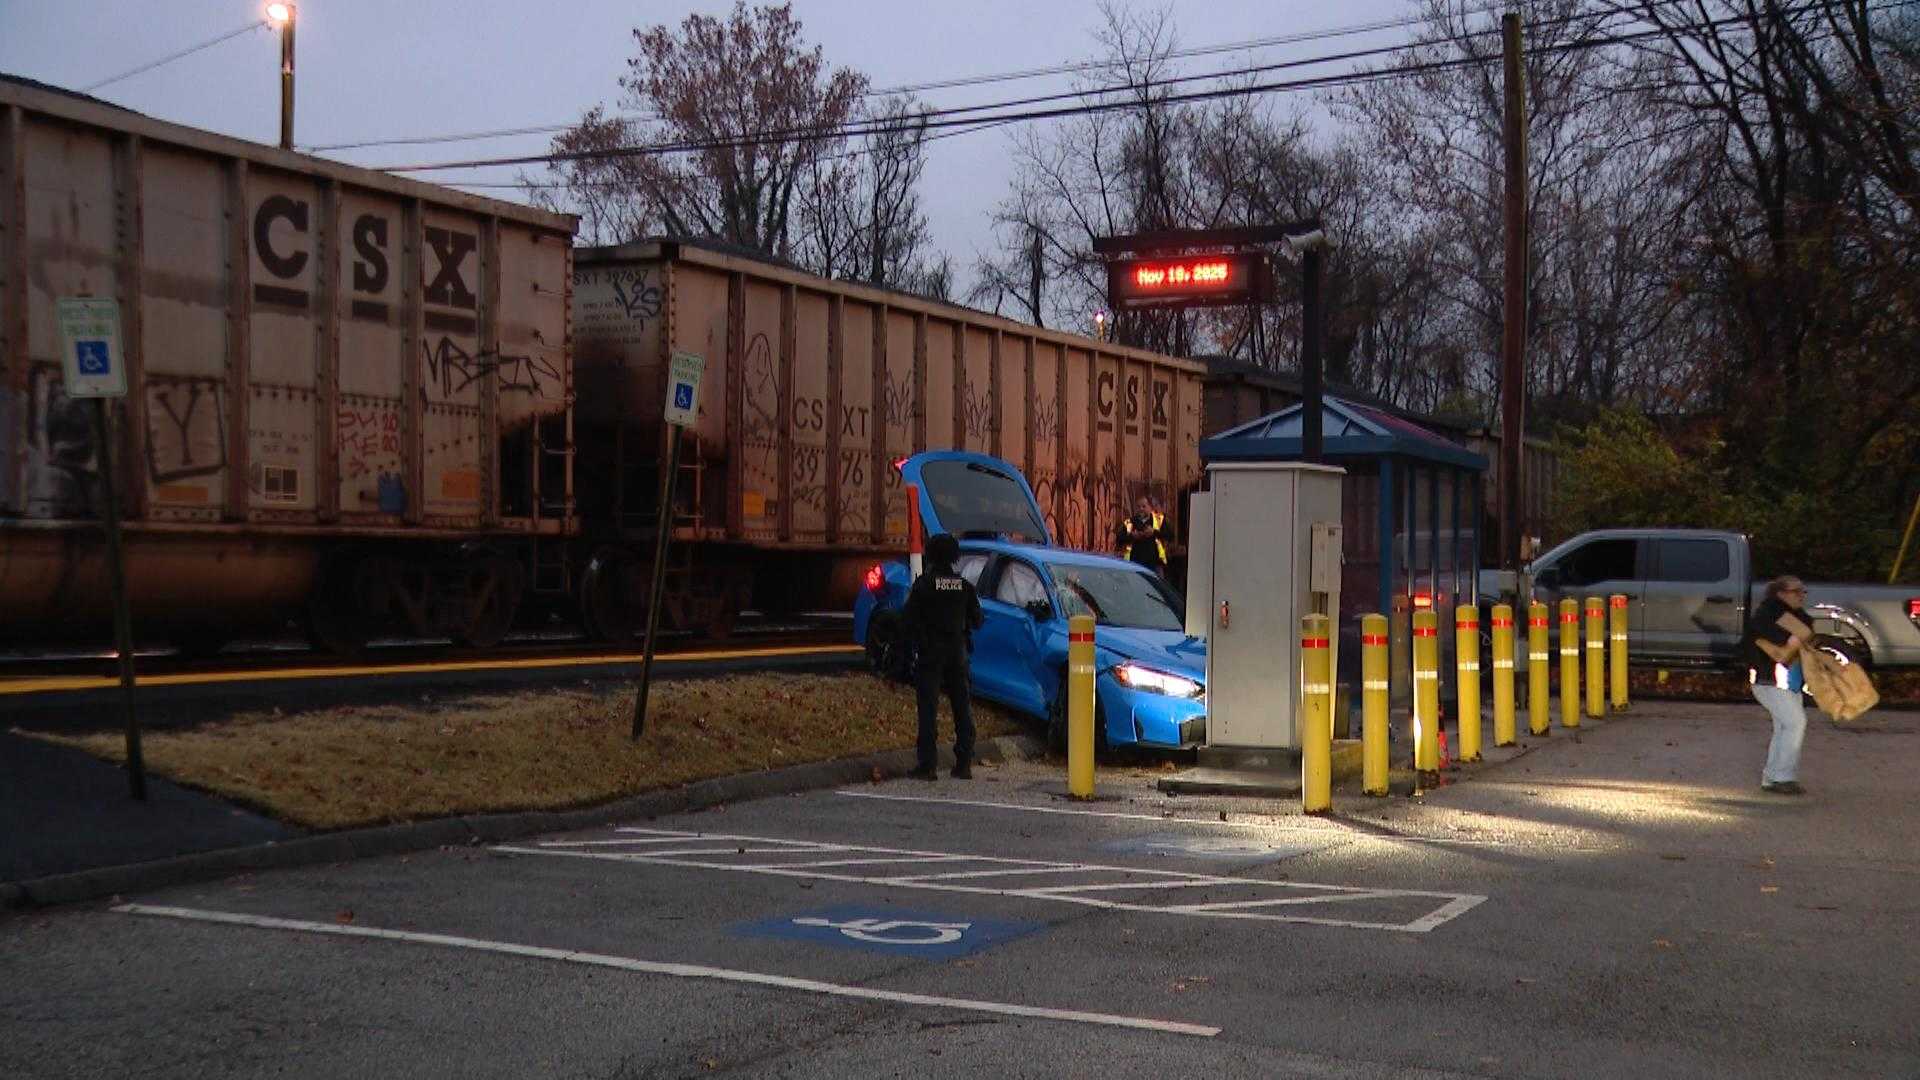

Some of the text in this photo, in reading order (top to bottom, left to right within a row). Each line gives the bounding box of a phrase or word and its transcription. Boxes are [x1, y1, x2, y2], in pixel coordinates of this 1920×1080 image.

[254, 194, 476, 309] CSX
[573, 272, 599, 286] SXT
[1137, 267, 1164, 285] Nov
[1098, 371, 1168, 426] CSX
[935, 582, 962, 591] POLICE
